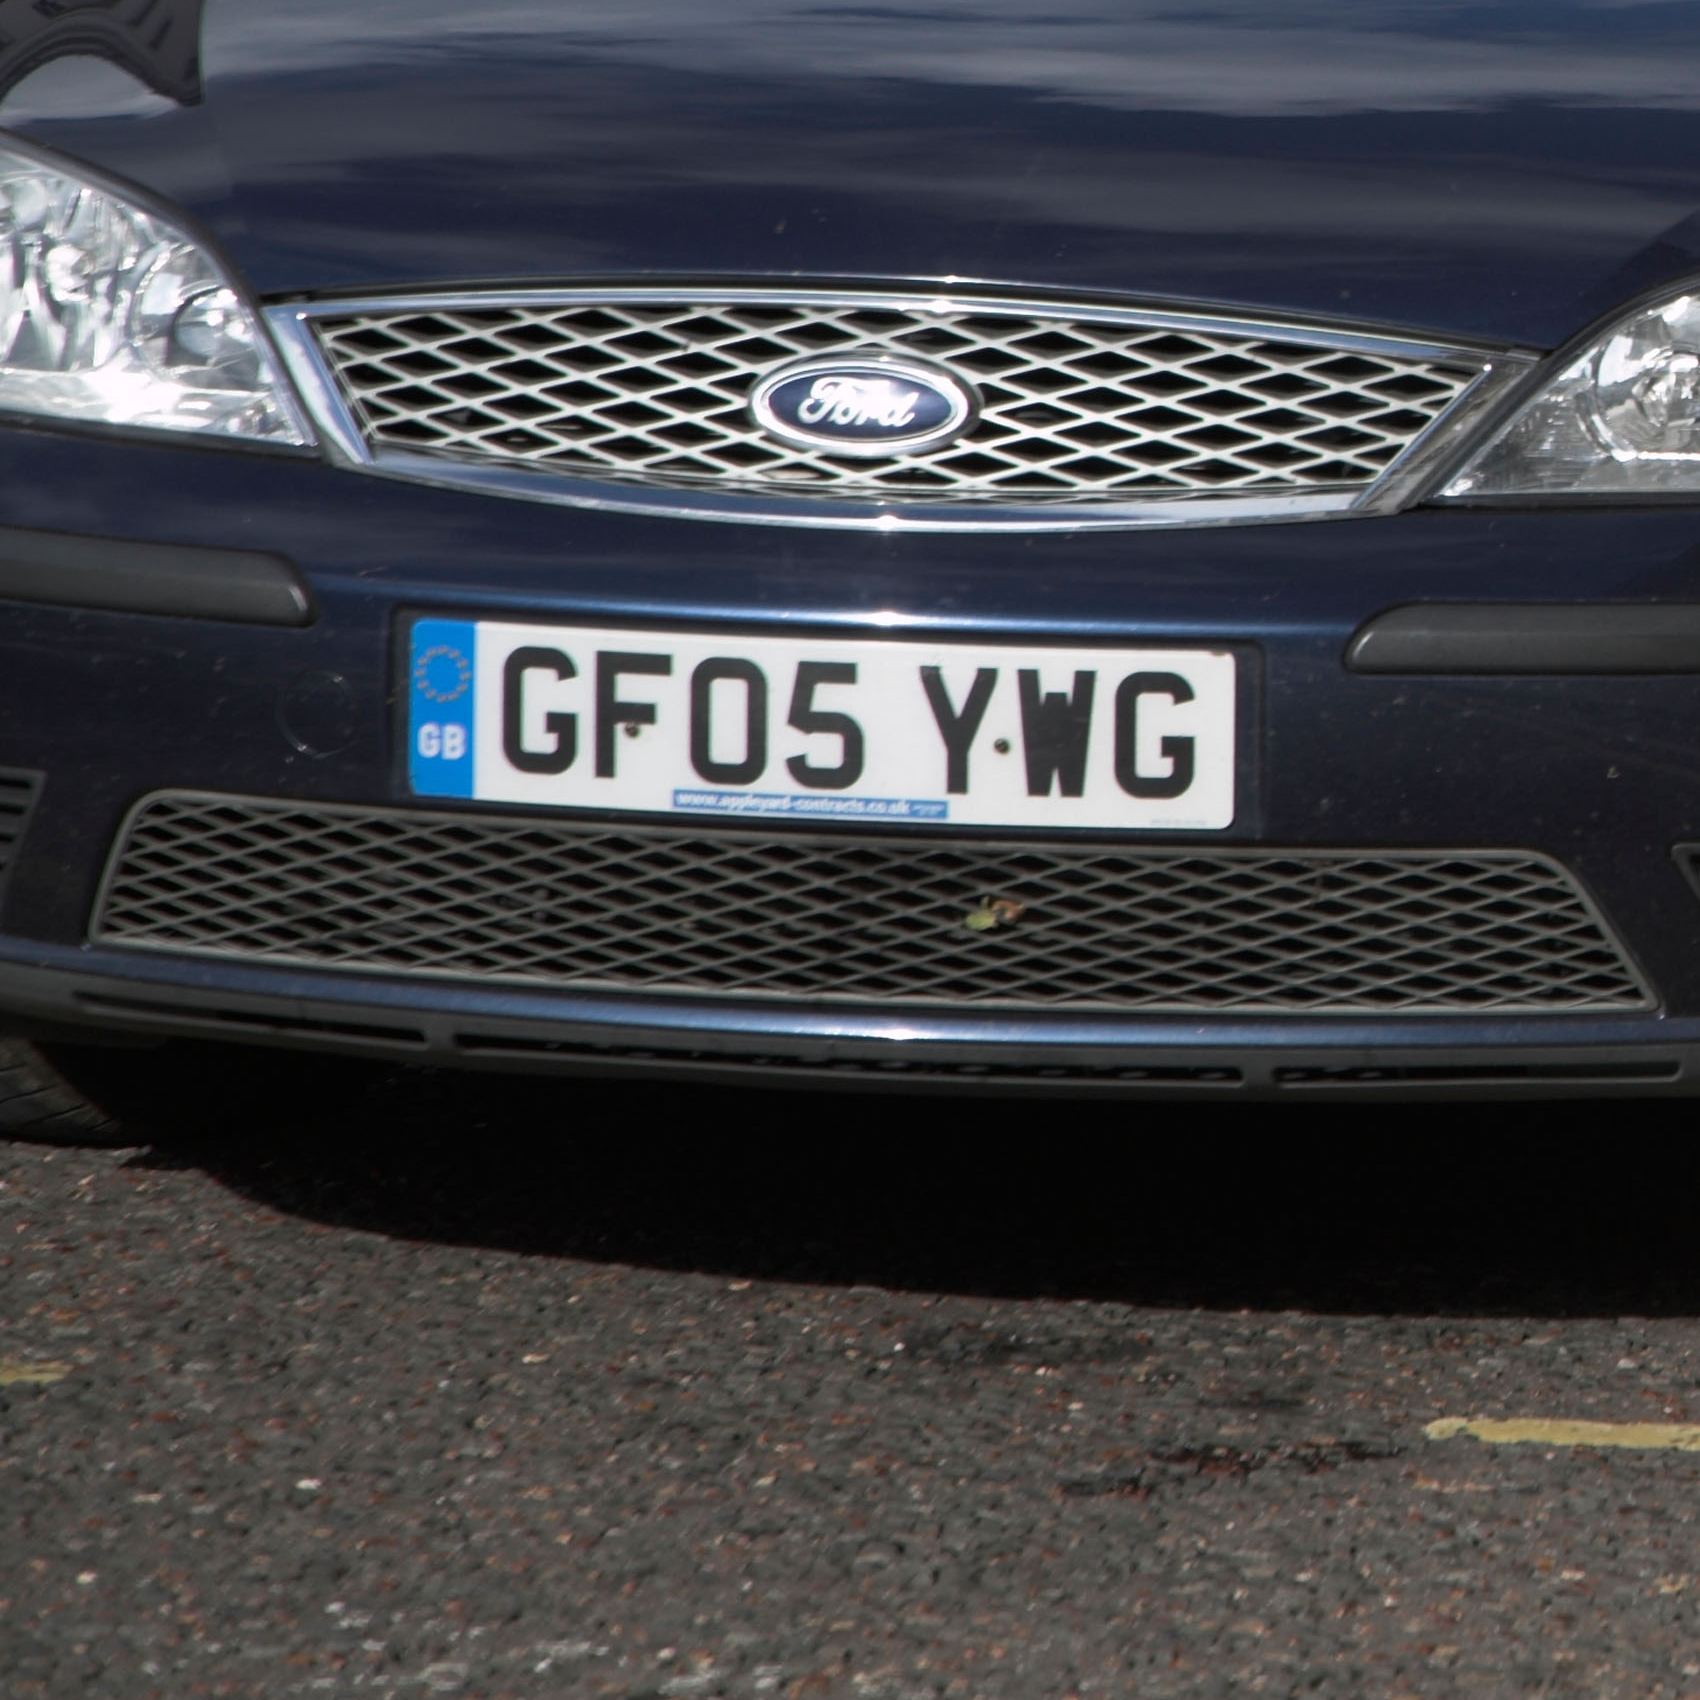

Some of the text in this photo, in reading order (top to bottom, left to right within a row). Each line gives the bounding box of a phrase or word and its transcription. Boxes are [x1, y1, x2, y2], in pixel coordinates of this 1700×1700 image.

[798, 376, 919, 427] Ford
[417, 722, 466, 760] GB
[502, 645, 1197, 800] GF05 YWG
